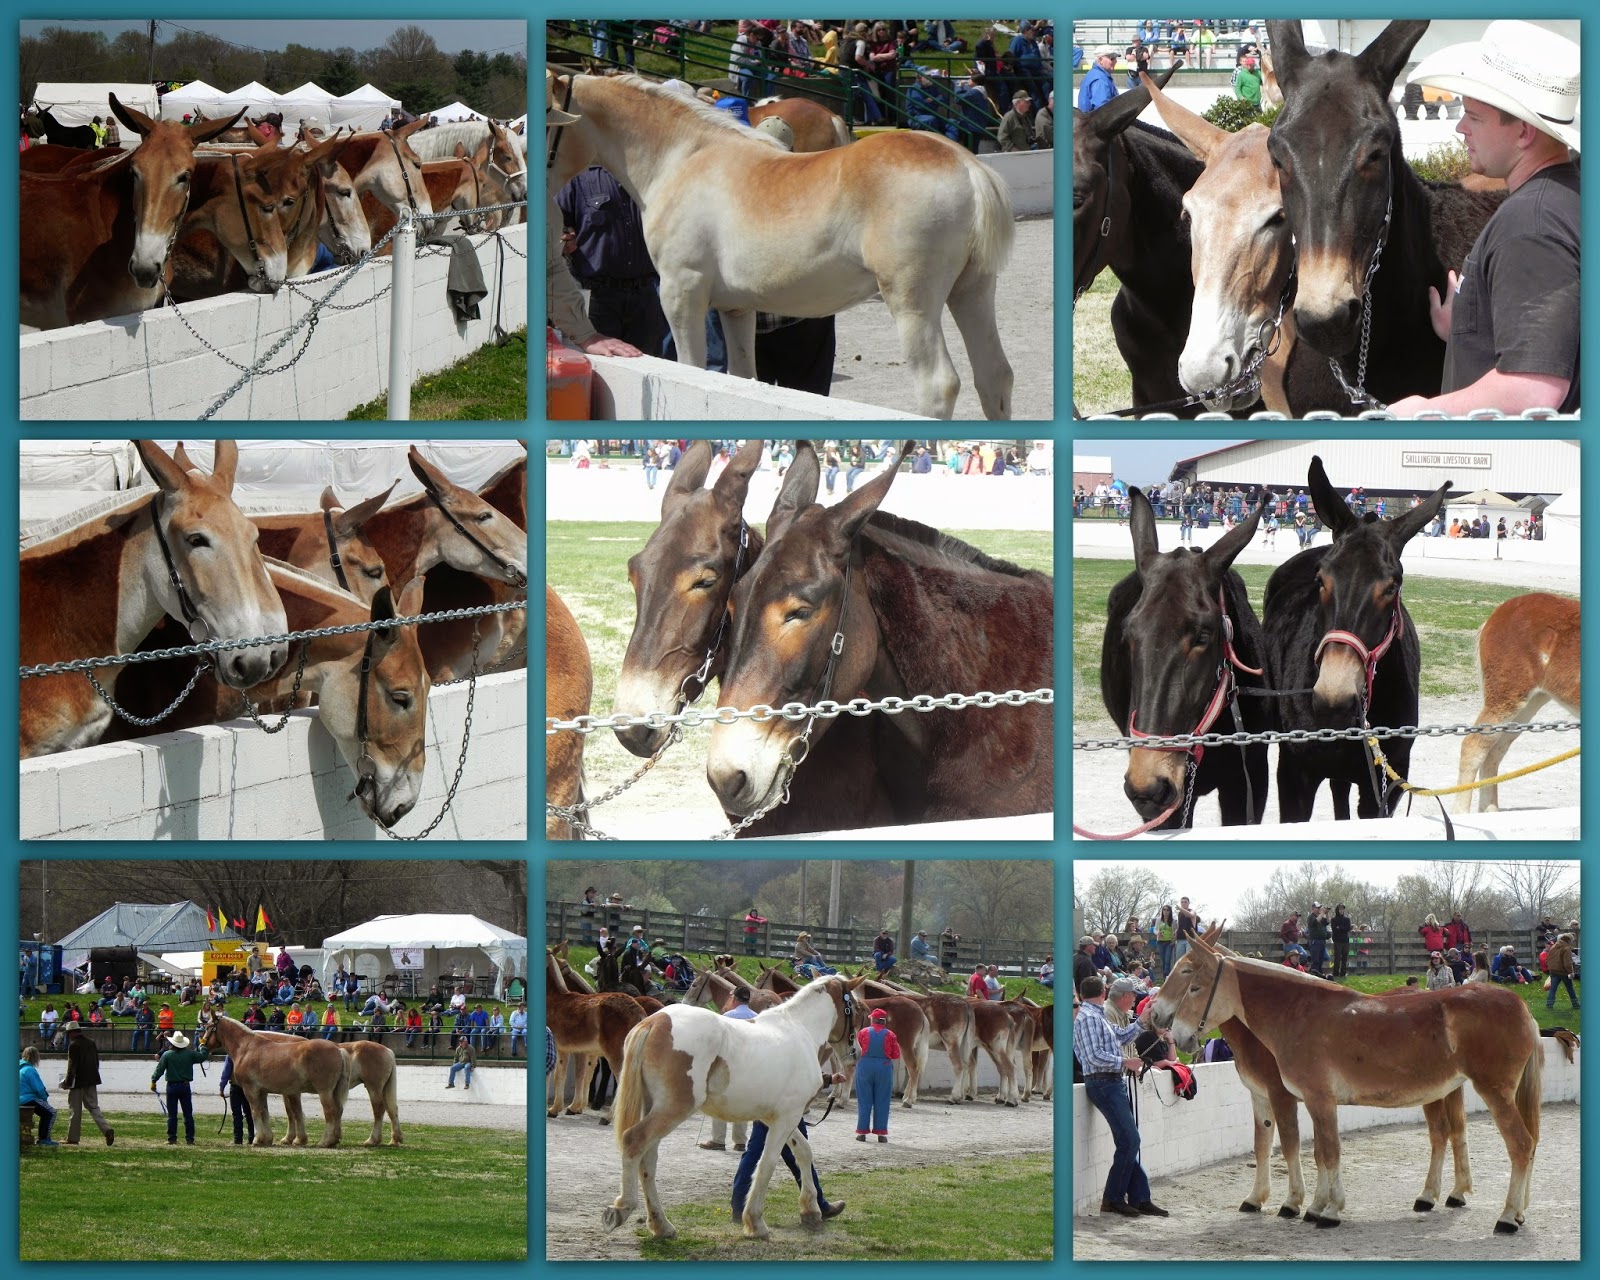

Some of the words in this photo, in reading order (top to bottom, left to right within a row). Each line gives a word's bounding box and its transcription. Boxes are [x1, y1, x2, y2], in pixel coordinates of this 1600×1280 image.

[1405, 454, 1441, 464] SKILLINGTON
[1443, 455, 1471, 465] LIVESTOCK
[1473, 456, 1488, 465] BARN
